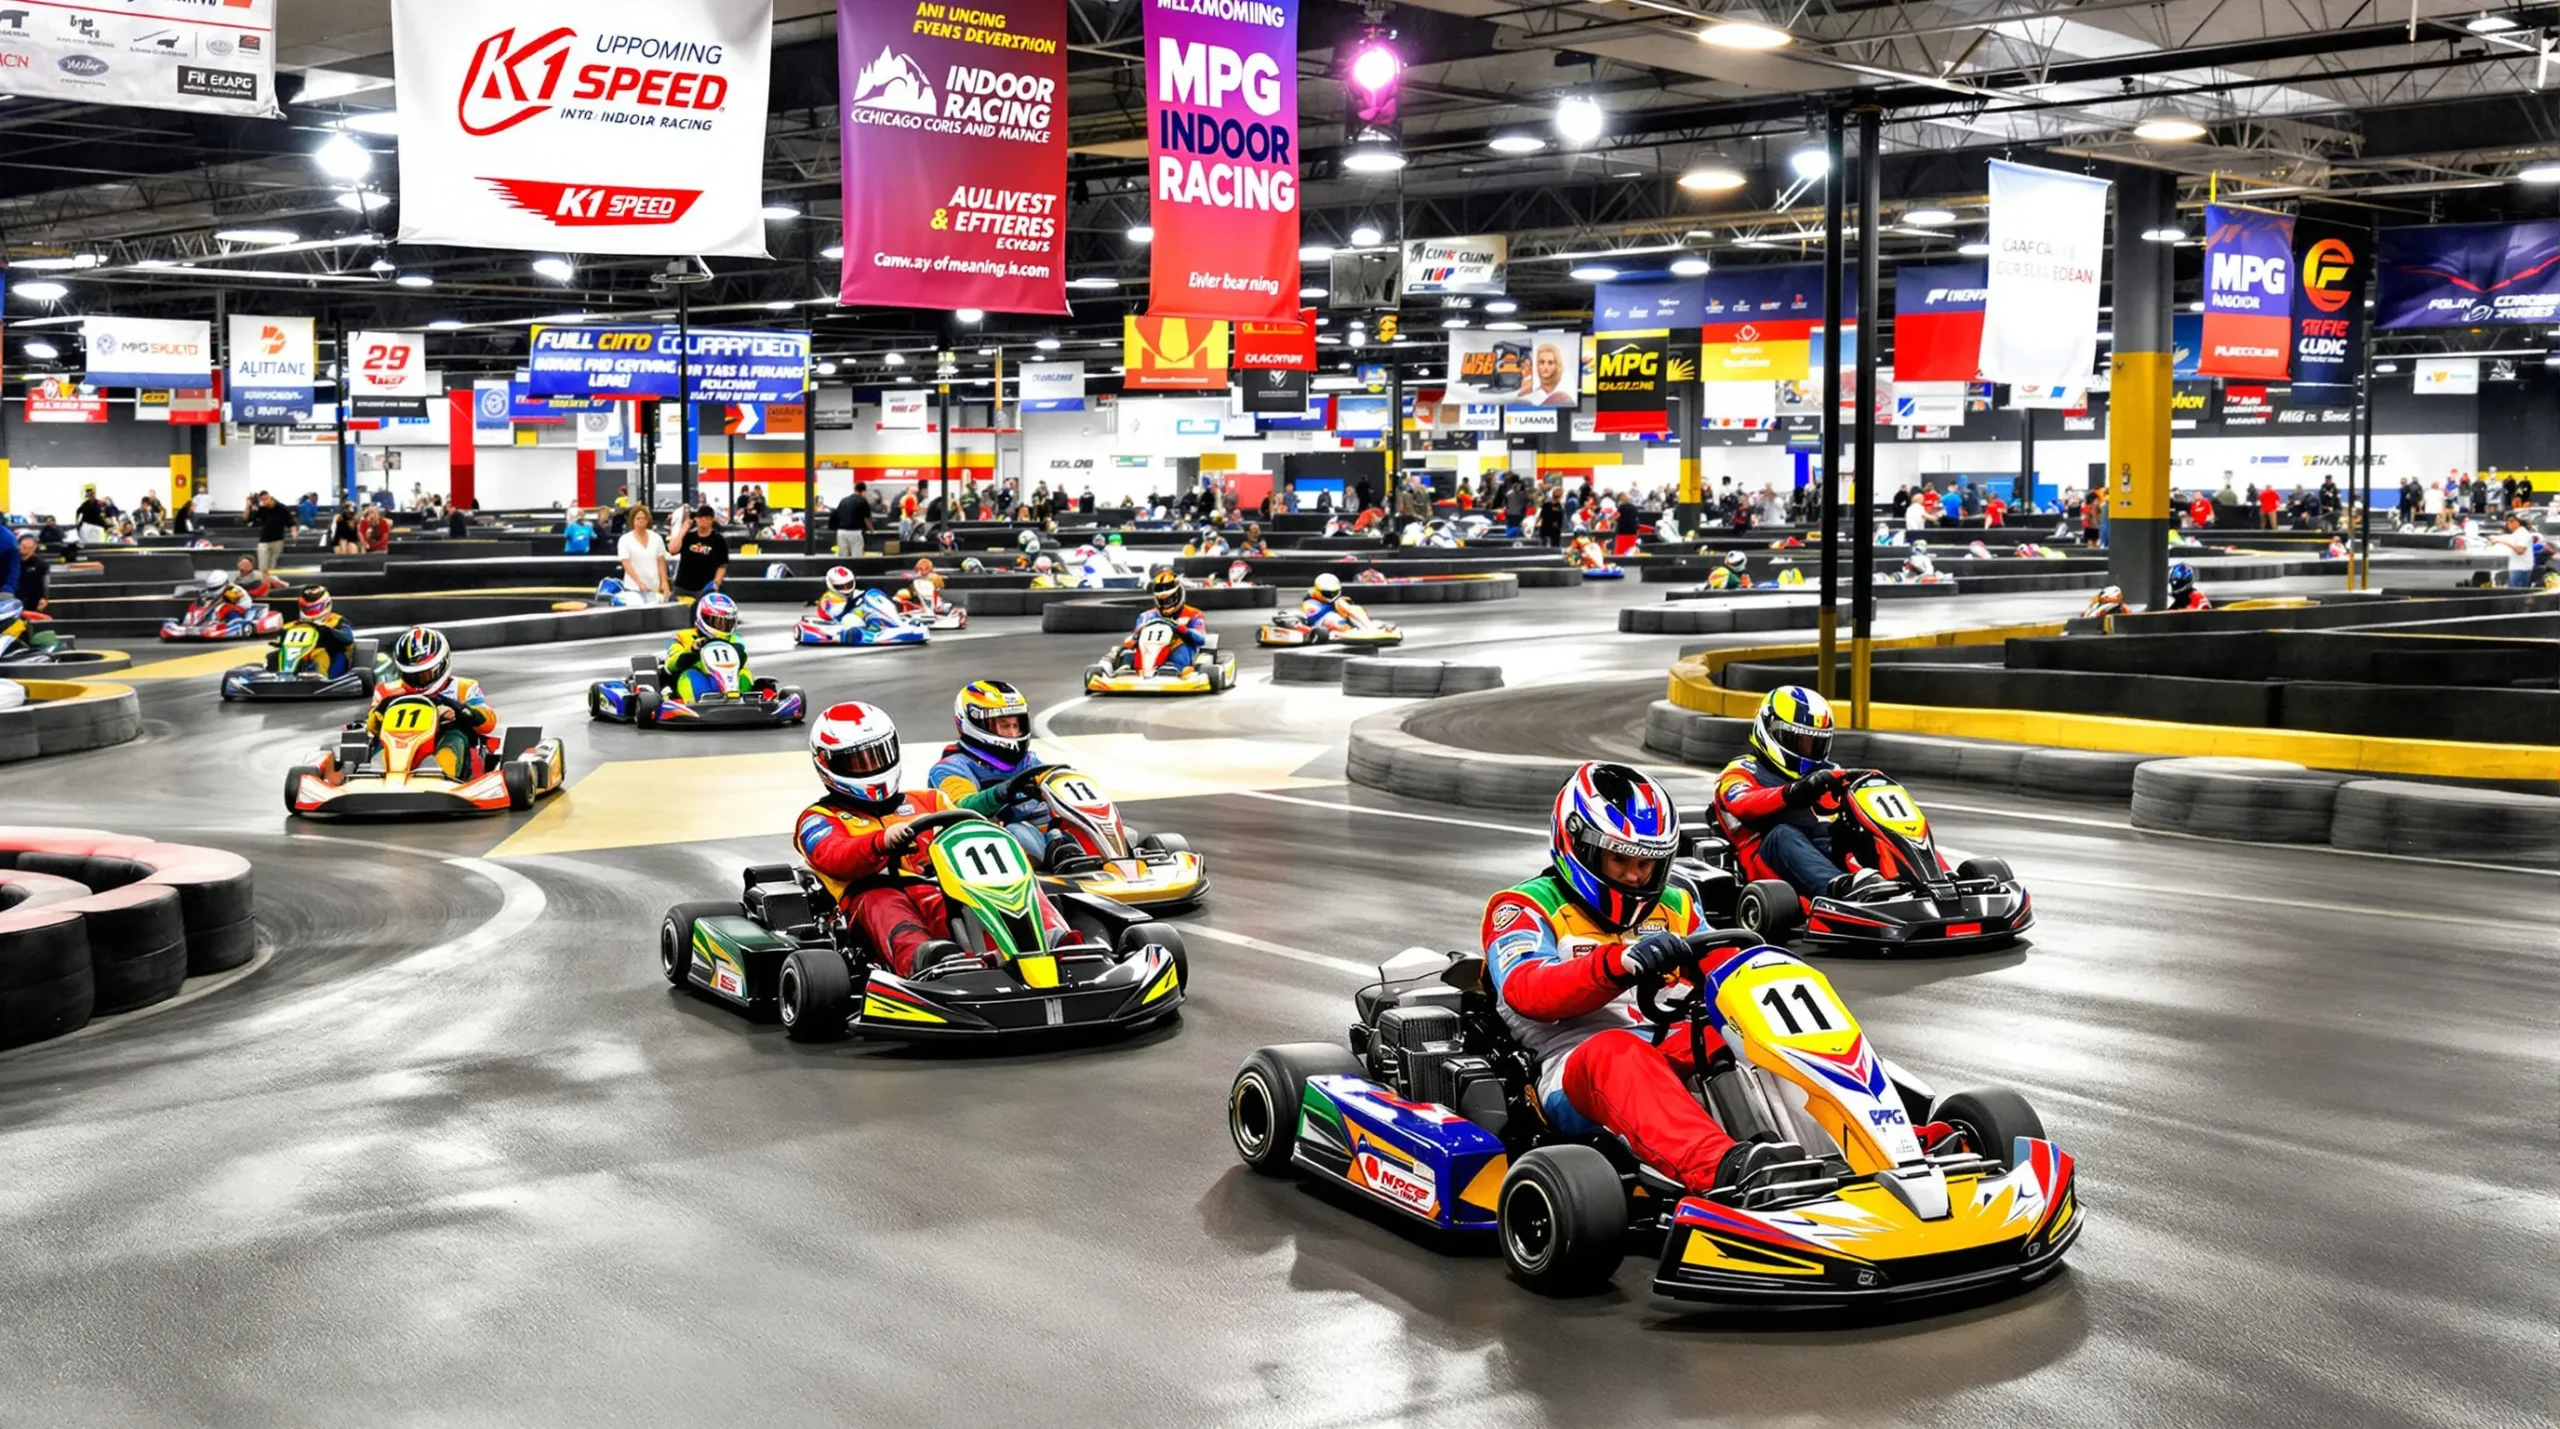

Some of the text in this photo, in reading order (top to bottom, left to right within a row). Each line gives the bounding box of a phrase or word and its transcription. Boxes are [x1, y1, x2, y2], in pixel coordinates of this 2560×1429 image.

[595, 34, 723, 65] UPPOMING
[572, 64, 728, 112] SPEED
[946, 65, 1055, 104] INDOOR
[1159, 37, 1281, 117] MPG
[660, 115, 713, 131] RACING
[944, 93, 1052, 129] RACING
[1160, 109, 1290, 166] INDOOR
[948, 185, 1057, 215] AULIVEST
[1158, 155, 1296, 213] RACING
[556, 187, 676, 219] K1 SPEED
[930, 208, 948, 231] &
[2211, 252, 2286, 295] MPG
[363, 344, 411, 370] 29
[1599, 351, 1660, 378] MPG
[394, 708, 423, 729] 11
[1063, 779, 1098, 802] 11
[1876, 793, 1909, 818] 11
[964, 842, 1009, 875] 11
[1761, 984, 1833, 1035] 11
